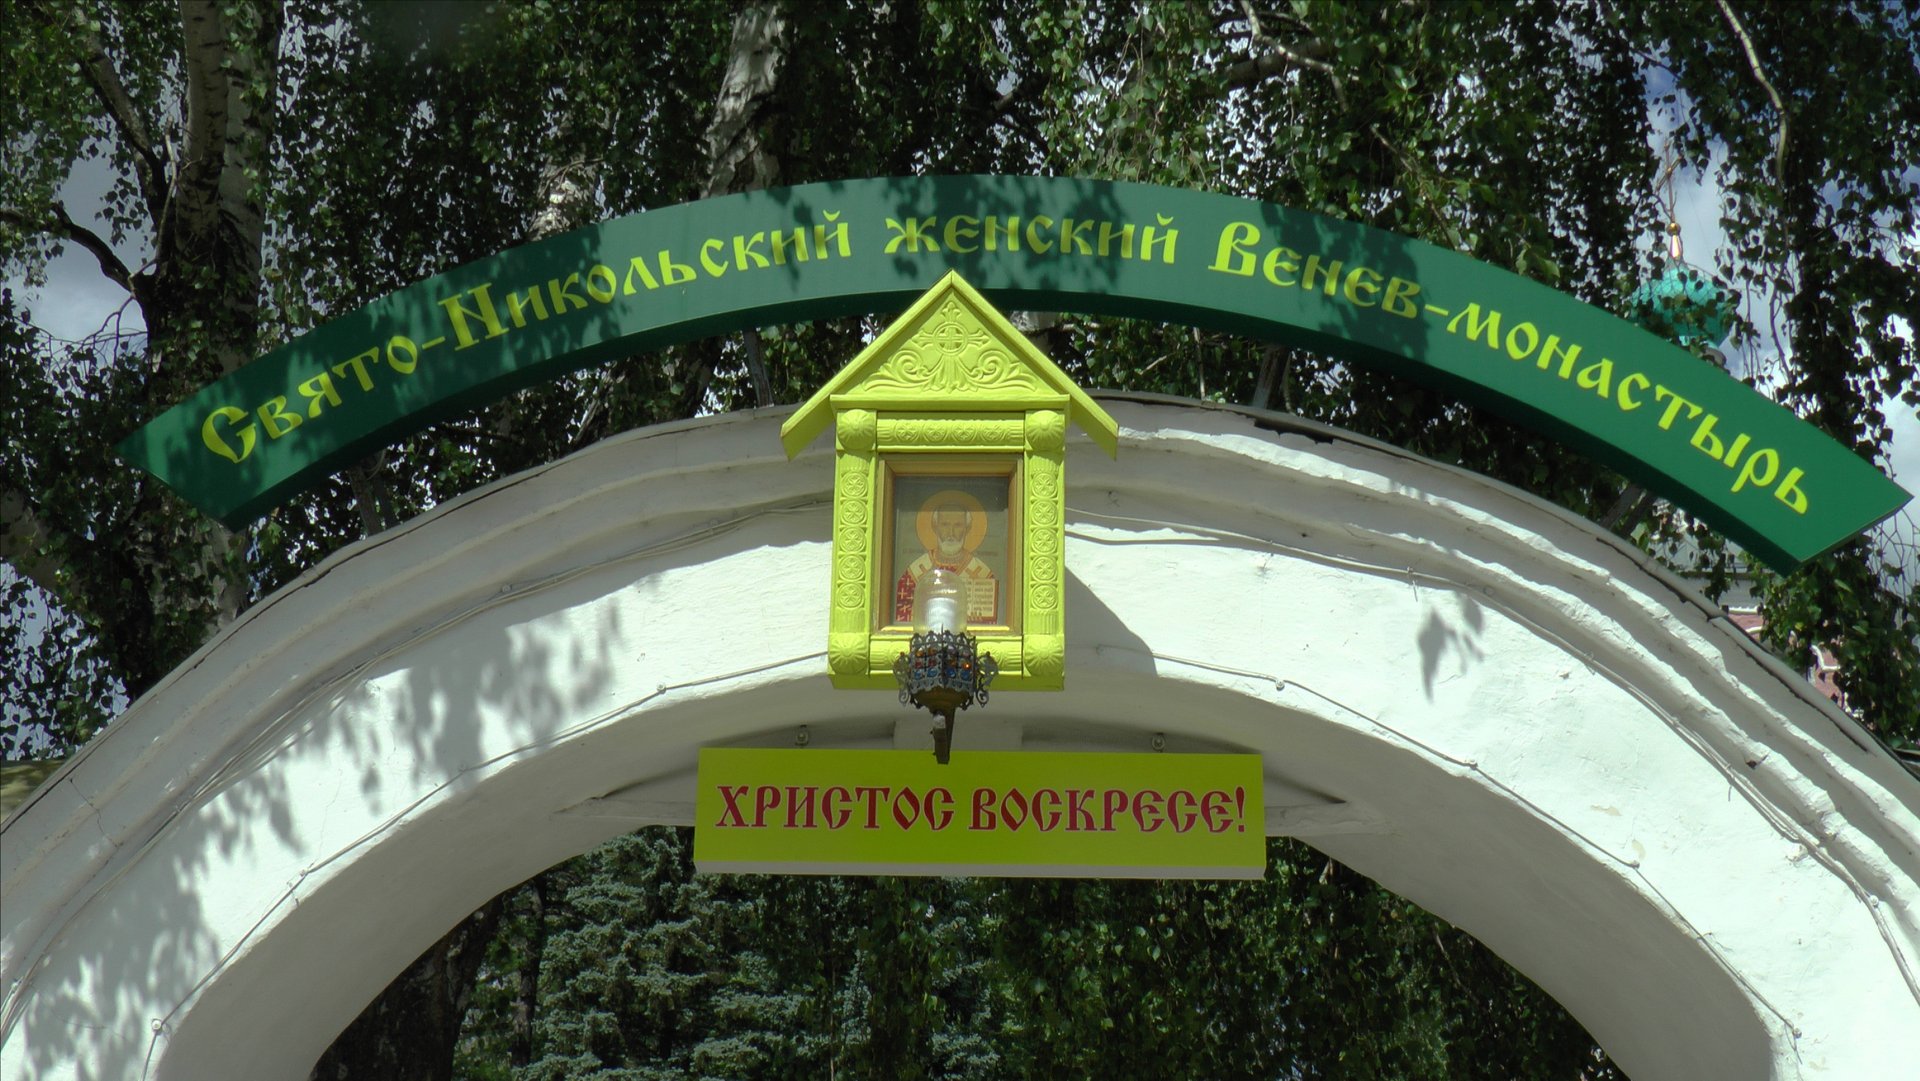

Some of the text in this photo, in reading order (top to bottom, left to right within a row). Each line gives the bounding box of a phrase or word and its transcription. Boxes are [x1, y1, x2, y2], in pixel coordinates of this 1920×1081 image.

[202, 210, 1808, 515] Свято-Никольский женский Венев-монастырь
[715, 786, 1246, 833] ХРИСТОС ВОСКРЕСЕ!
